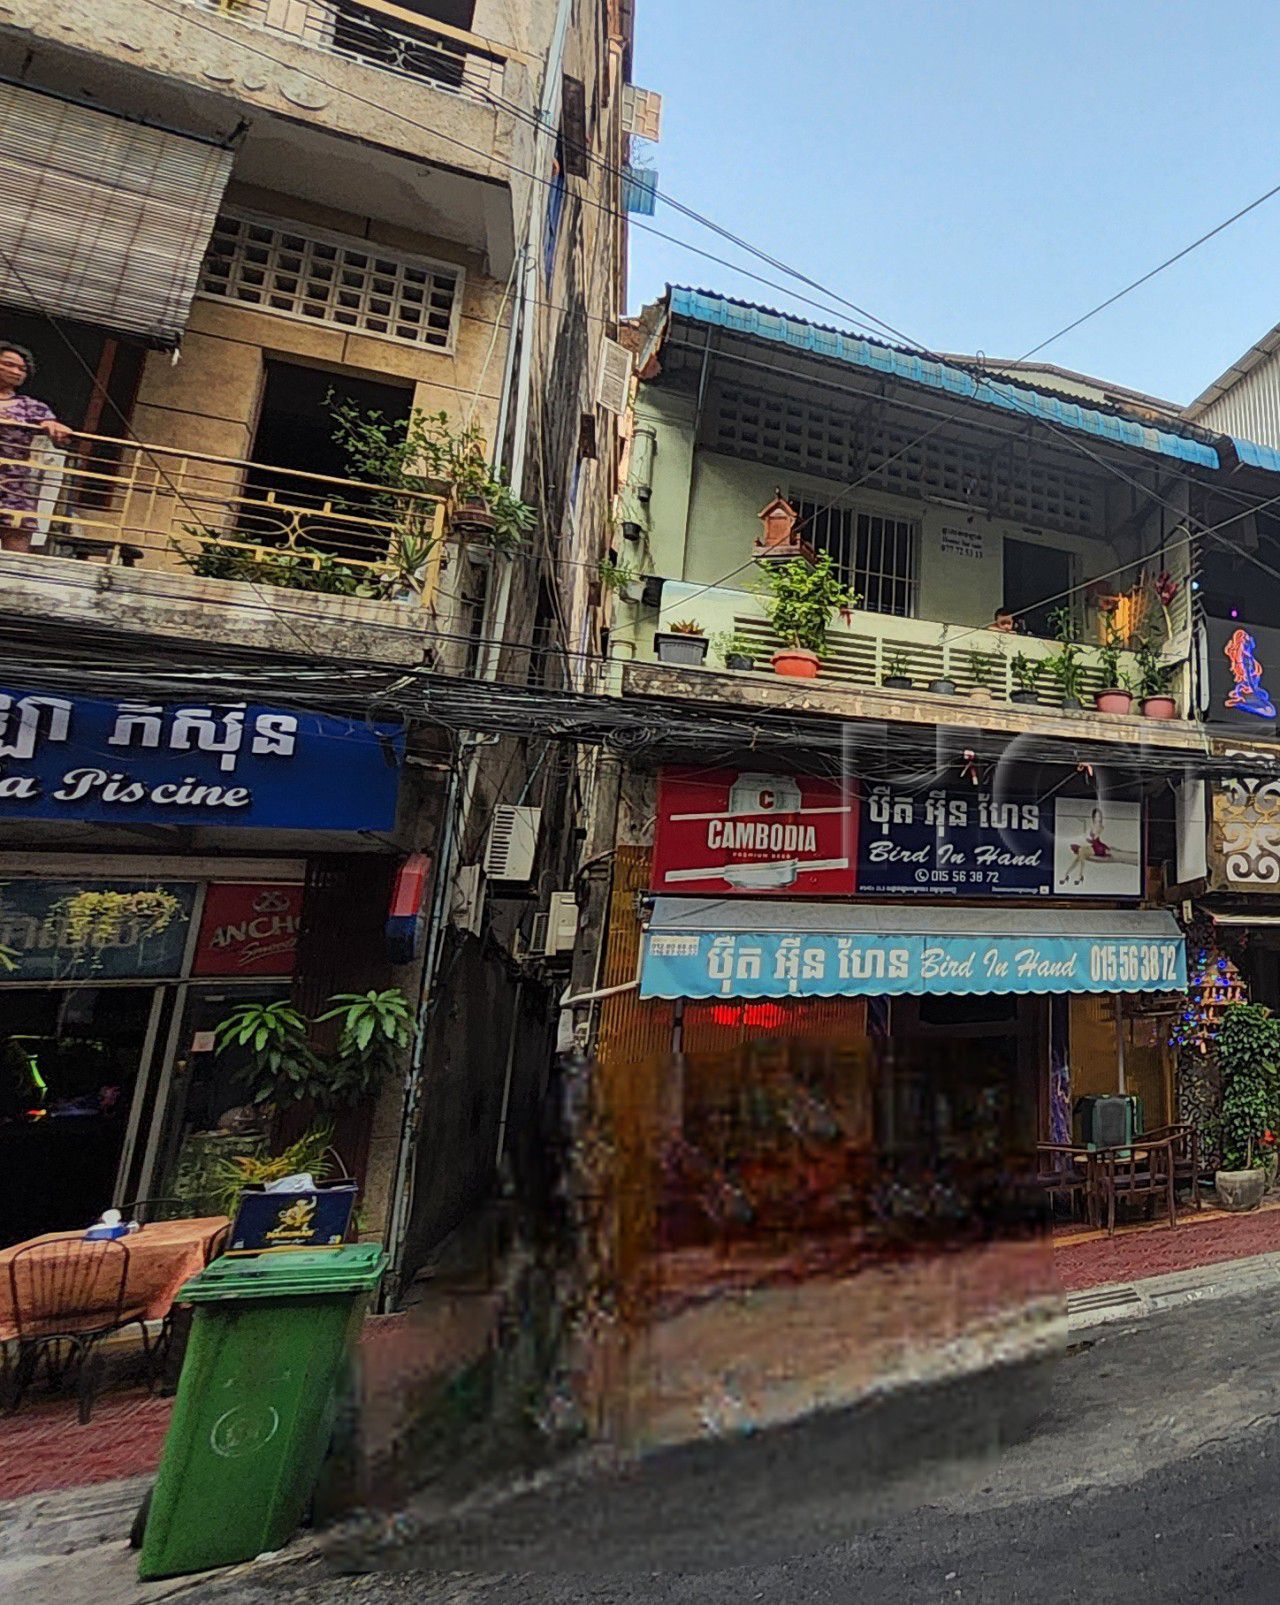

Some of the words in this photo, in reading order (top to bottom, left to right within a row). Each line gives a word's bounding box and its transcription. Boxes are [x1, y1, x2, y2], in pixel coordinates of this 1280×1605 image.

[0, 776, 37, 798] a
[53, 768, 250, 807] Piscine
[707, 820, 816, 852] CAMBODIA
[869, 840, 930, 863] Bird
[937, 844, 965, 864] In
[974, 845, 1042, 867] Hand
[931, 870, 949, 882] 015
[952, 870, 966, 882] 56
[969, 870, 983, 883] 38
[986, 871, 999, 883] 72
[921, 948, 976, 978] Bird
[983, 946, 1008, 978] In
[1015, 948, 1078, 978] Hand
